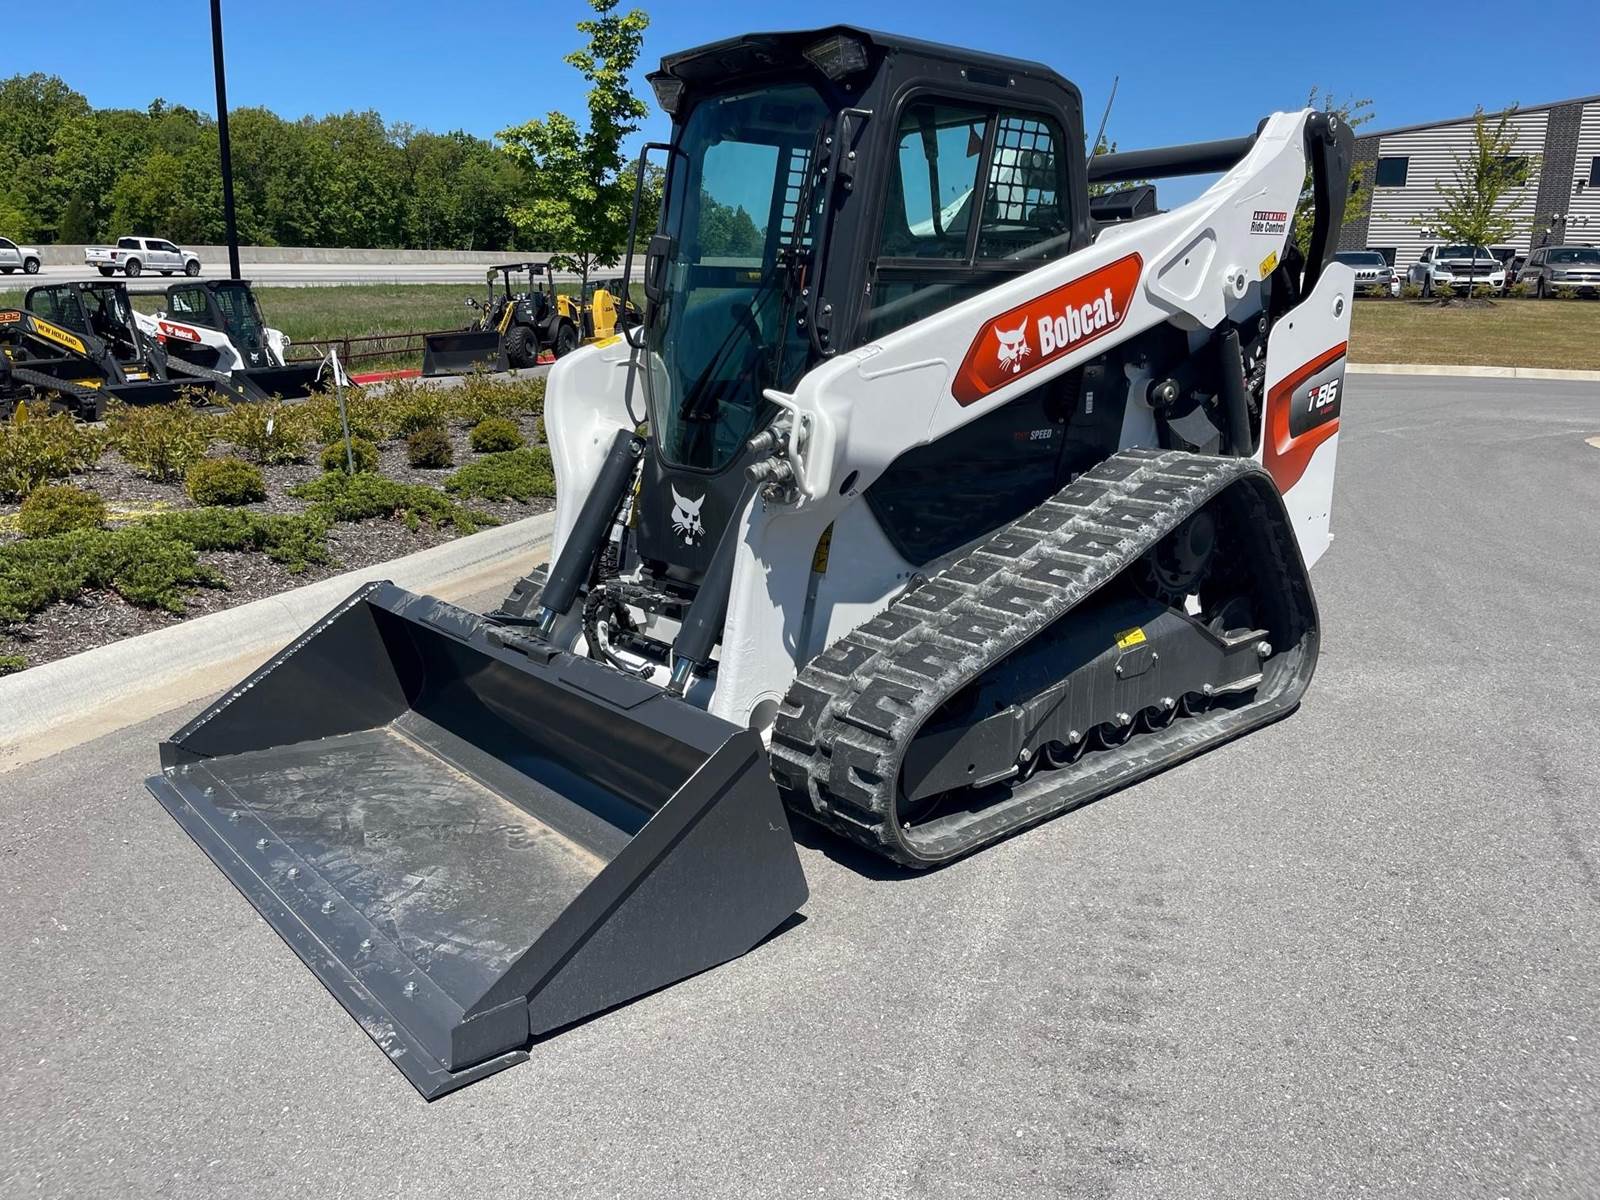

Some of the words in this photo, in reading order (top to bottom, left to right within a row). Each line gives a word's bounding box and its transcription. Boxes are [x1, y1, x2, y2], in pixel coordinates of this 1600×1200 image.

[1253, 211, 1287, 221] AUTOMATIC
[1250, 221, 1264, 232] Ride
[1265, 222, 1286, 233] Control
[1038, 288, 1116, 357] Bobcat
[37, 324, 51, 335] NEW
[51, 329, 77, 346] HOLLAND
[1030, 429, 1052, 440] SPEED
